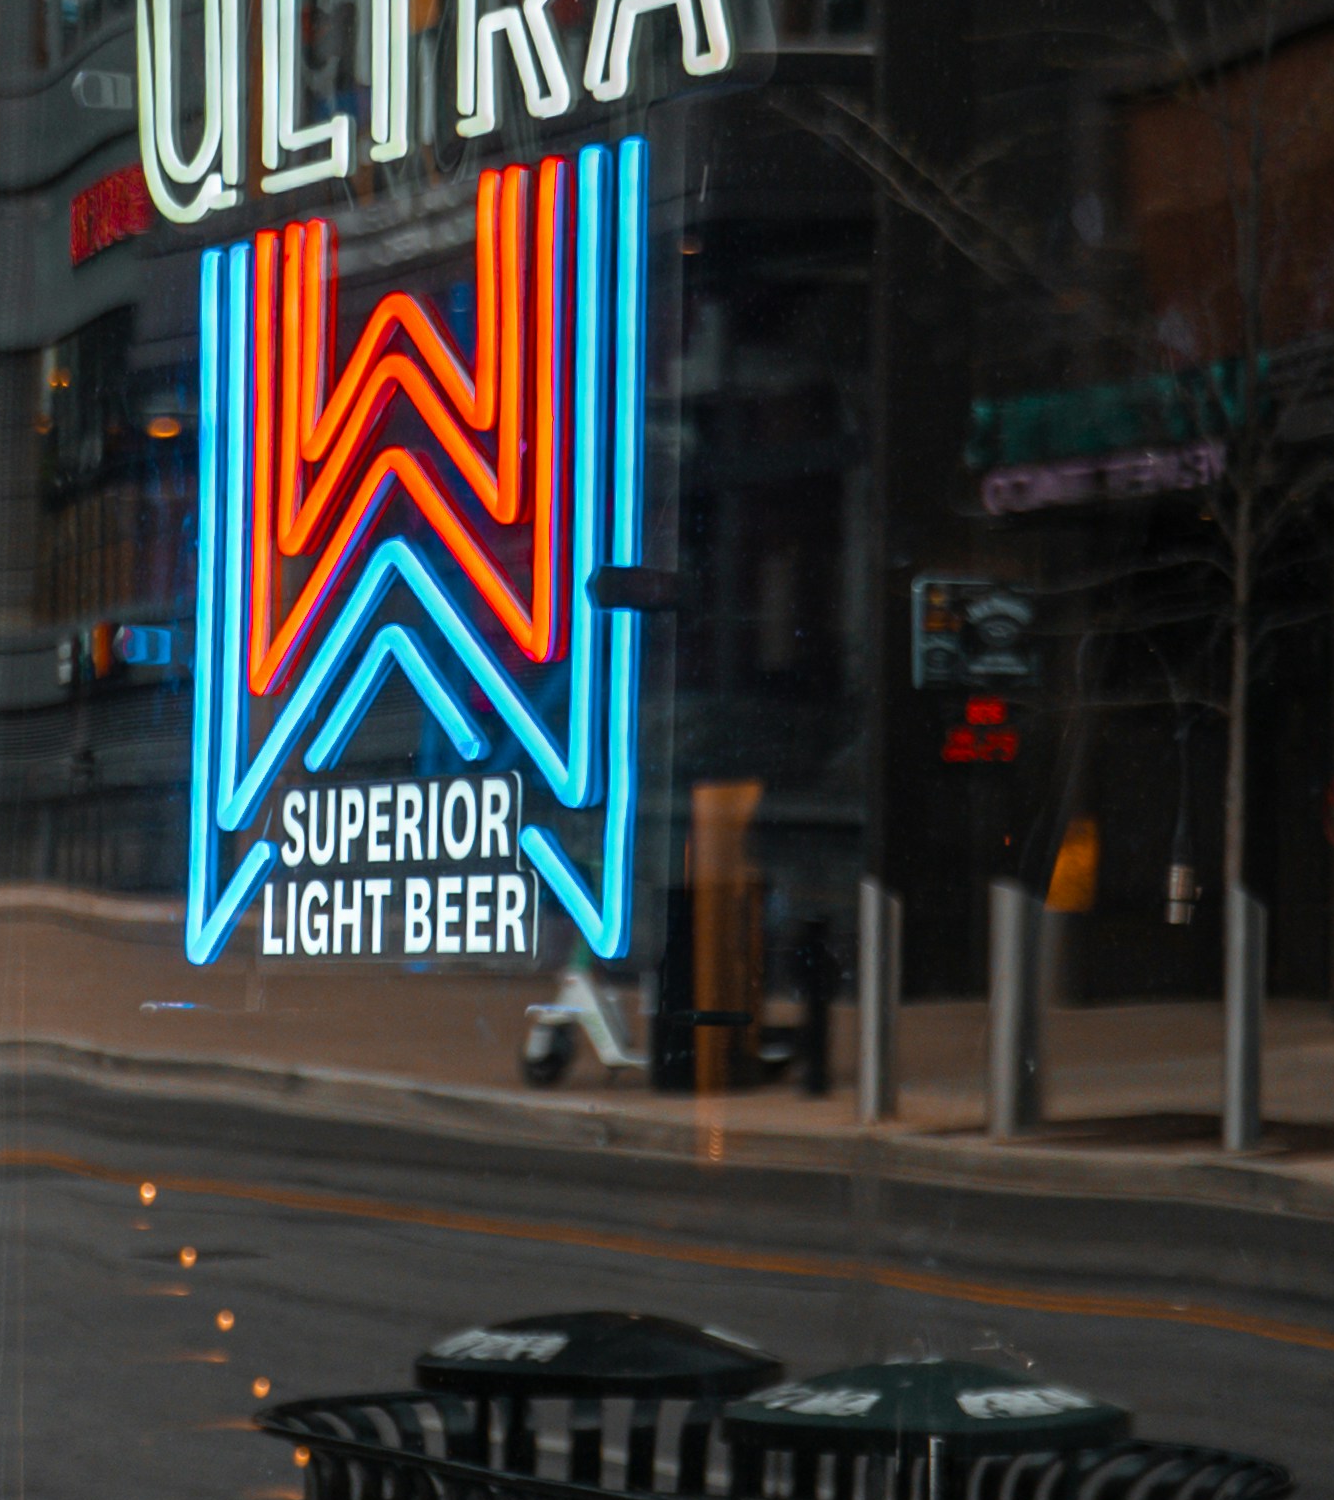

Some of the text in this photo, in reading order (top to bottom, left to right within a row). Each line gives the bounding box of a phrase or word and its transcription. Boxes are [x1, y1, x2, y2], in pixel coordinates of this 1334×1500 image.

[280, 778, 512, 868] SUPERIOR
[262, 874, 528, 956] LIGHT BEER
